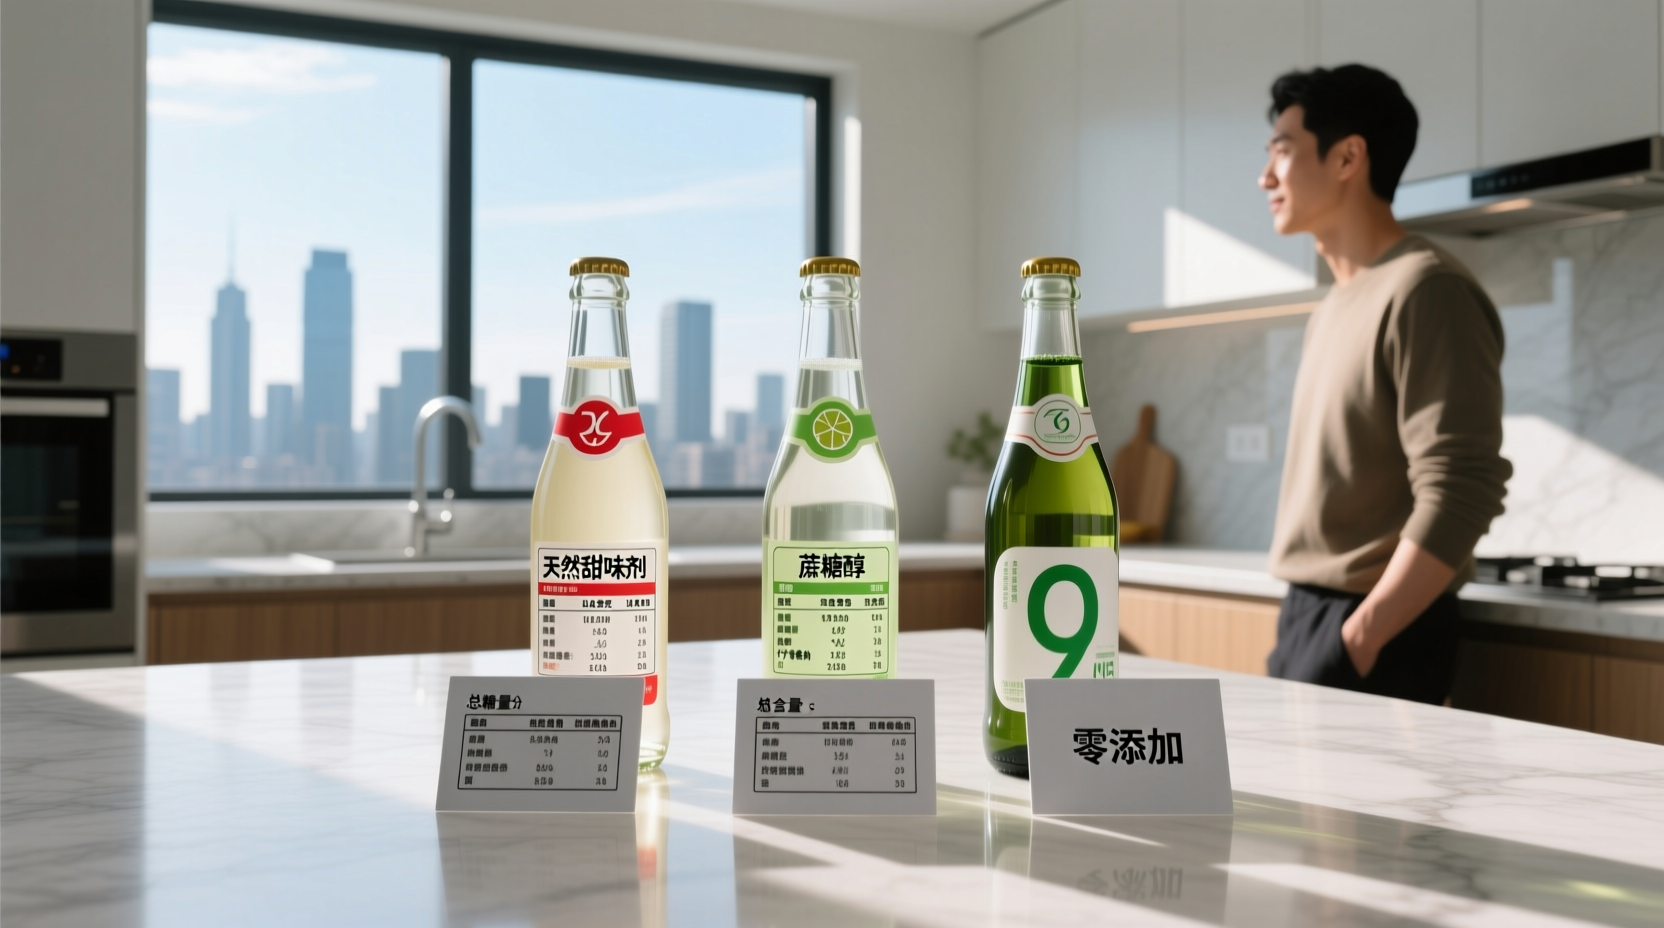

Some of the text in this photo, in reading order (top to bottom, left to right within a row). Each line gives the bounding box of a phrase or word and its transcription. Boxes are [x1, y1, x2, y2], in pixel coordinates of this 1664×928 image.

[543, 554, 646, 580] 天然甜味剂
[798, 552, 866, 579] 蔗糖醇
[1027, 563, 1099, 679] 9
[1072, 727, 1184, 766] 零添加
